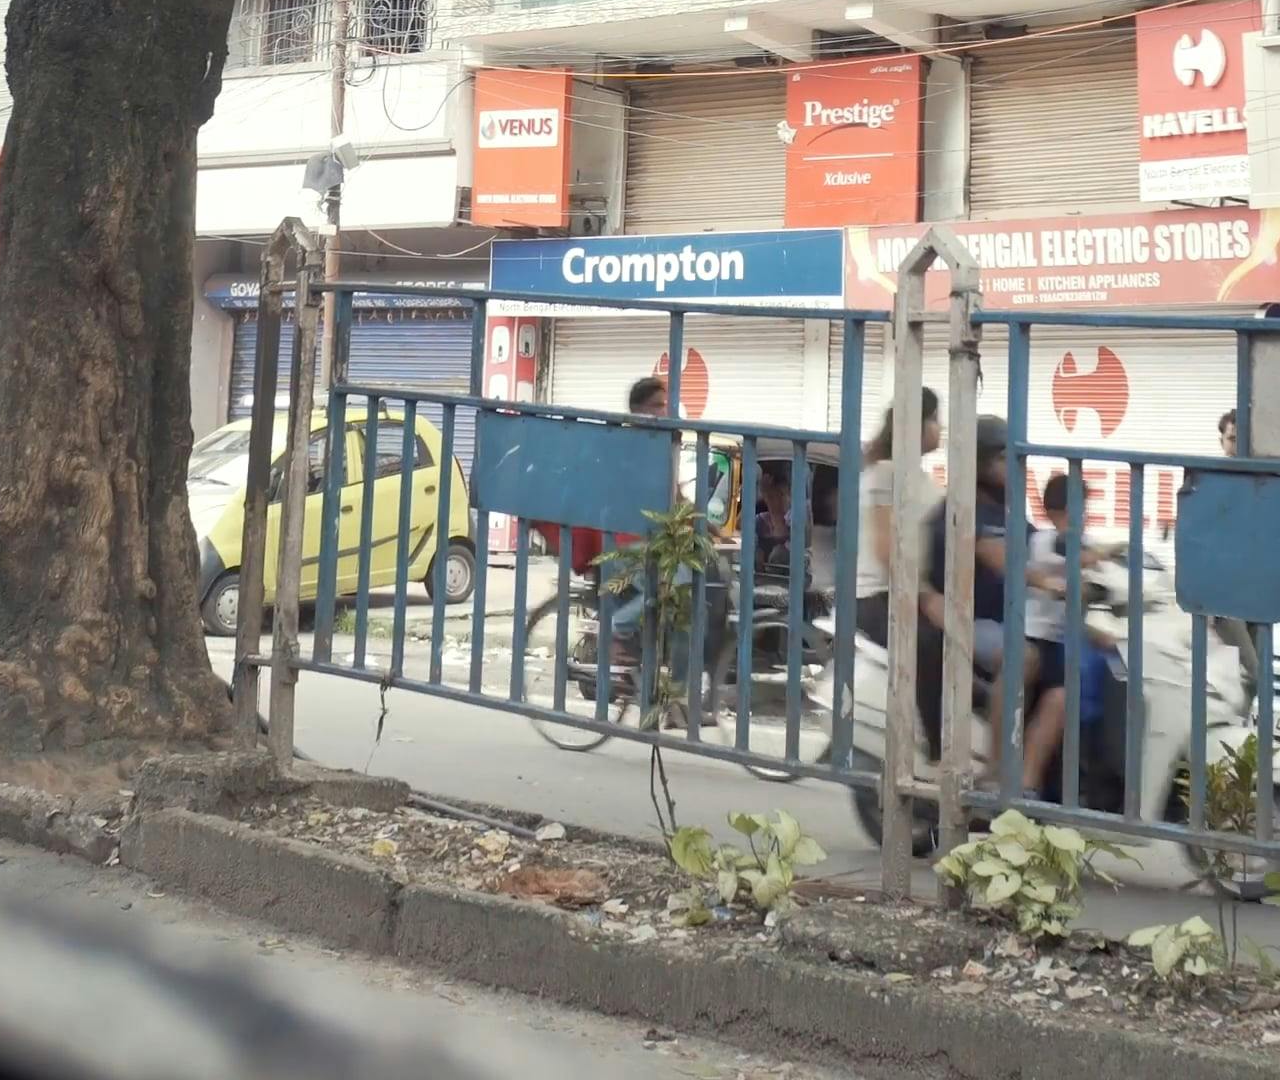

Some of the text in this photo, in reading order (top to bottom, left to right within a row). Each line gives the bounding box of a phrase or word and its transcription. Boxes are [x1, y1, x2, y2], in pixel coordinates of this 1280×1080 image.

[804, 98, 895, 129] Prestige
[1143, 106, 1247, 138] HAVELL
[498, 118, 552, 136] VENUS
[823, 171, 871, 186] Xclusive
[956, 230, 1037, 270] ENGAL
[1041, 224, 1150, 268] ELECTRIC
[1154, 219, 1251, 265] STORES
[561, 244, 745, 291] Crompton
[230, 282, 260, 297] GOYA
[993, 272, 1161, 292] HOME KITCHEN APPLIANCES
